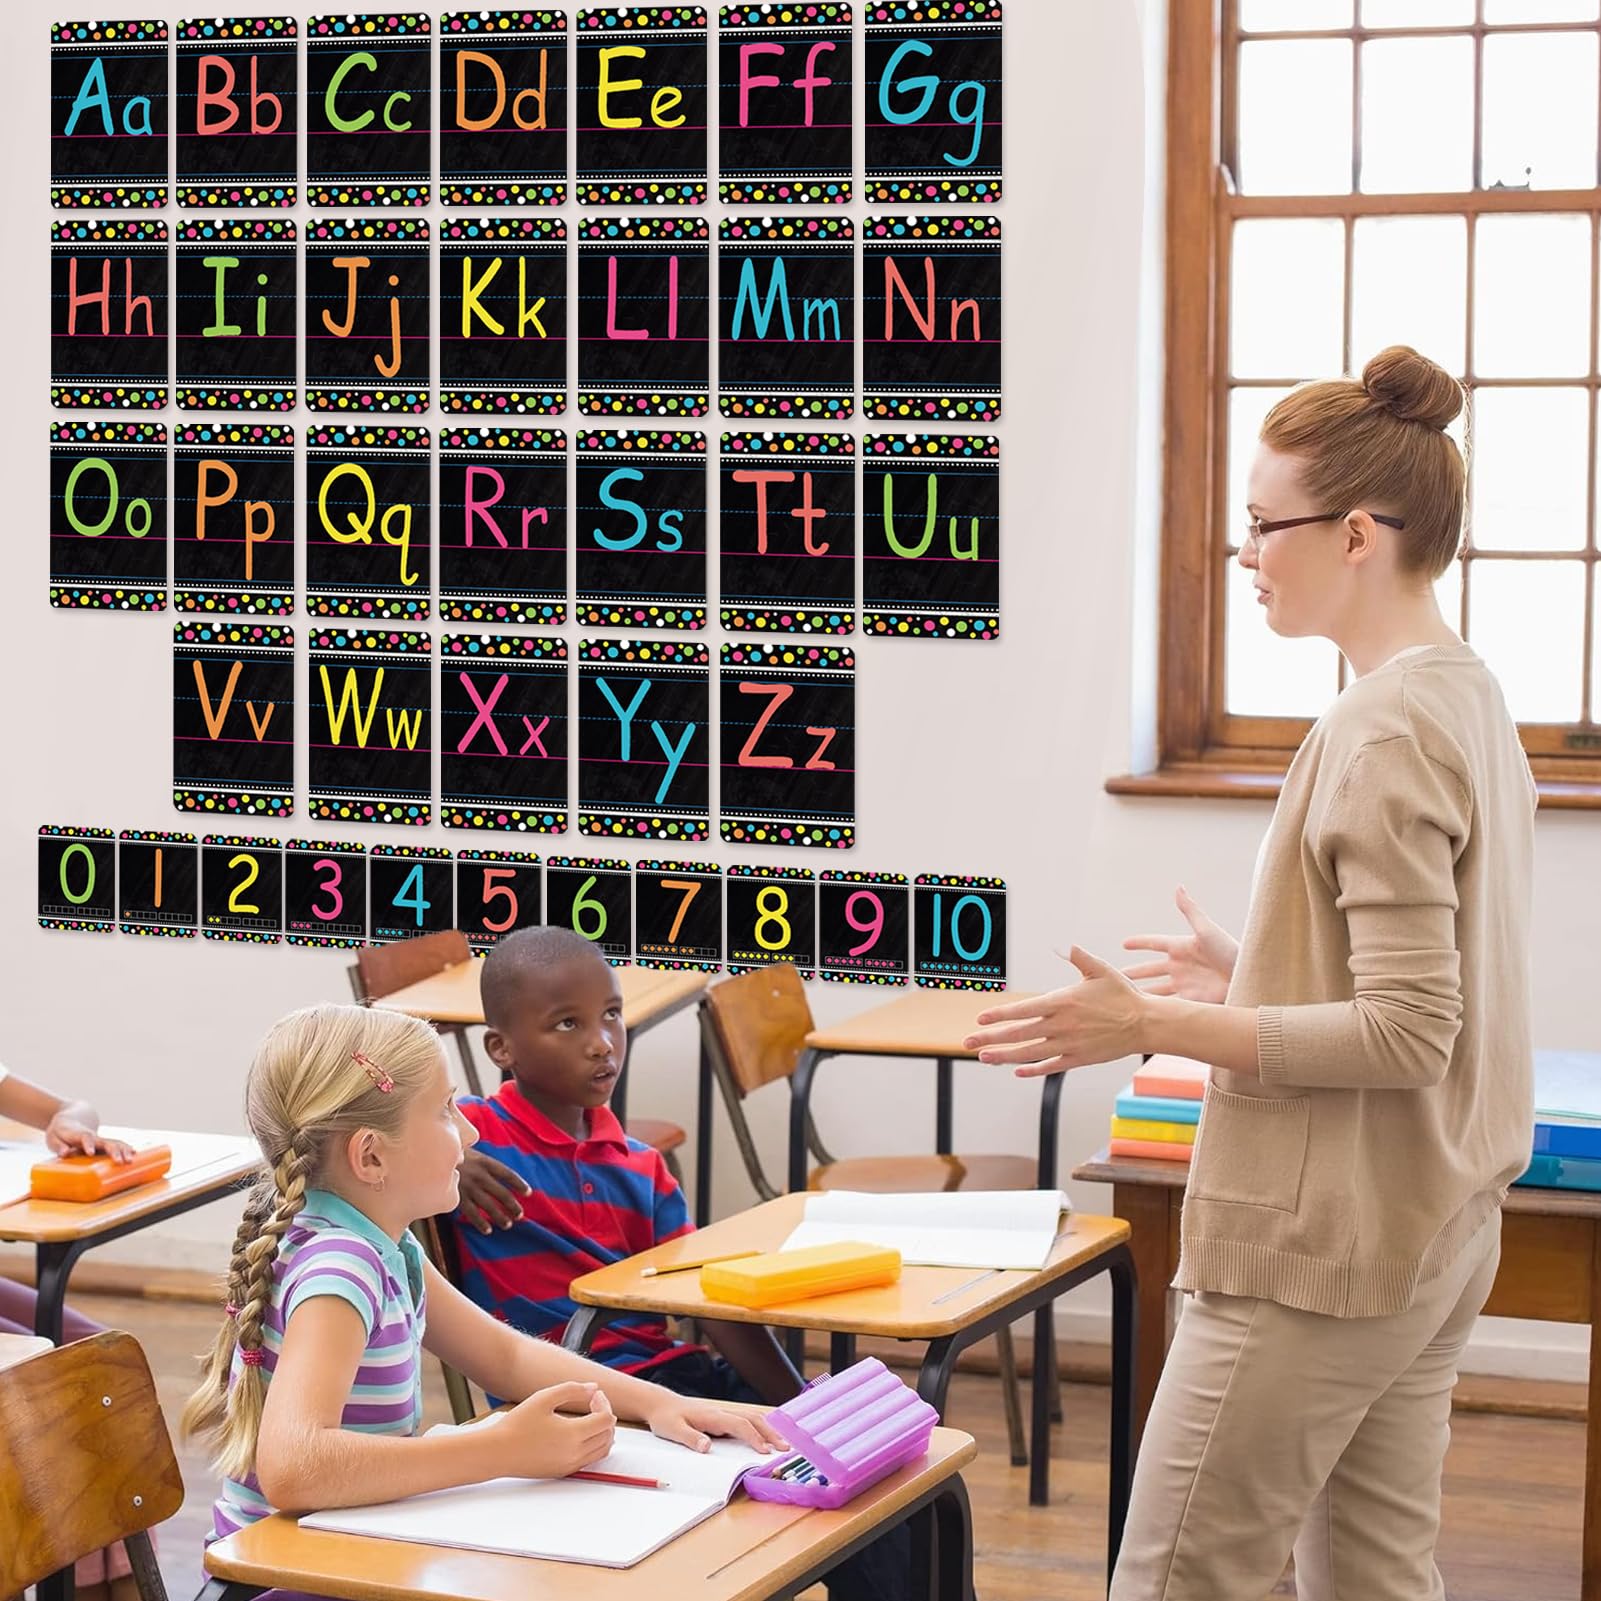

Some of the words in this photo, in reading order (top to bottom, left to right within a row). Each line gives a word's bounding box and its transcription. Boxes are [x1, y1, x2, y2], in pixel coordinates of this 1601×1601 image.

[64, 56, 153, 136] Aa
[196, 55, 283, 136] Bb
[324, 52, 411, 133] Cc
[456, 48, 548, 132] Dd
[598, 45, 686, 130] Ee
[739, 41, 836, 129] Ff
[878, 39, 986, 168] Gg
[68, 258, 154, 337] Hh
[202, 257, 268, 337] Ii
[322, 257, 402, 378] Jj
[462, 255, 547, 340] Kk
[731, 255, 841, 341] Mm
[884, 256, 981, 343] Nn
[64, 457, 152, 538] Oo
[196, 459, 275, 581] Pp
[318, 463, 419, 587] Qq
[464, 465, 548, 550] Rr
[593, 467, 683, 553] Ss
[732, 470, 830, 557] Tt
[883, 474, 979, 561] Uu
[192, 660, 275, 743] Vv
[319, 665, 423, 751] Ww
[457, 671, 550, 759] Xx
[595, 677, 696, 805] Yy
[738, 682, 836, 771] Zz
[59, 843, 96, 904] 0
[228, 853, 260, 914] 2
[311, 859, 343, 921] 3
[392, 864, 431, 927] 4
[482, 868, 518, 932] 5
[572, 876, 607, 941] 6
[660, 879, 702, 944] 7
[754, 885, 792, 951] 8
[845, 890, 884, 957] 9
[932, 893, 992, 961] 10
